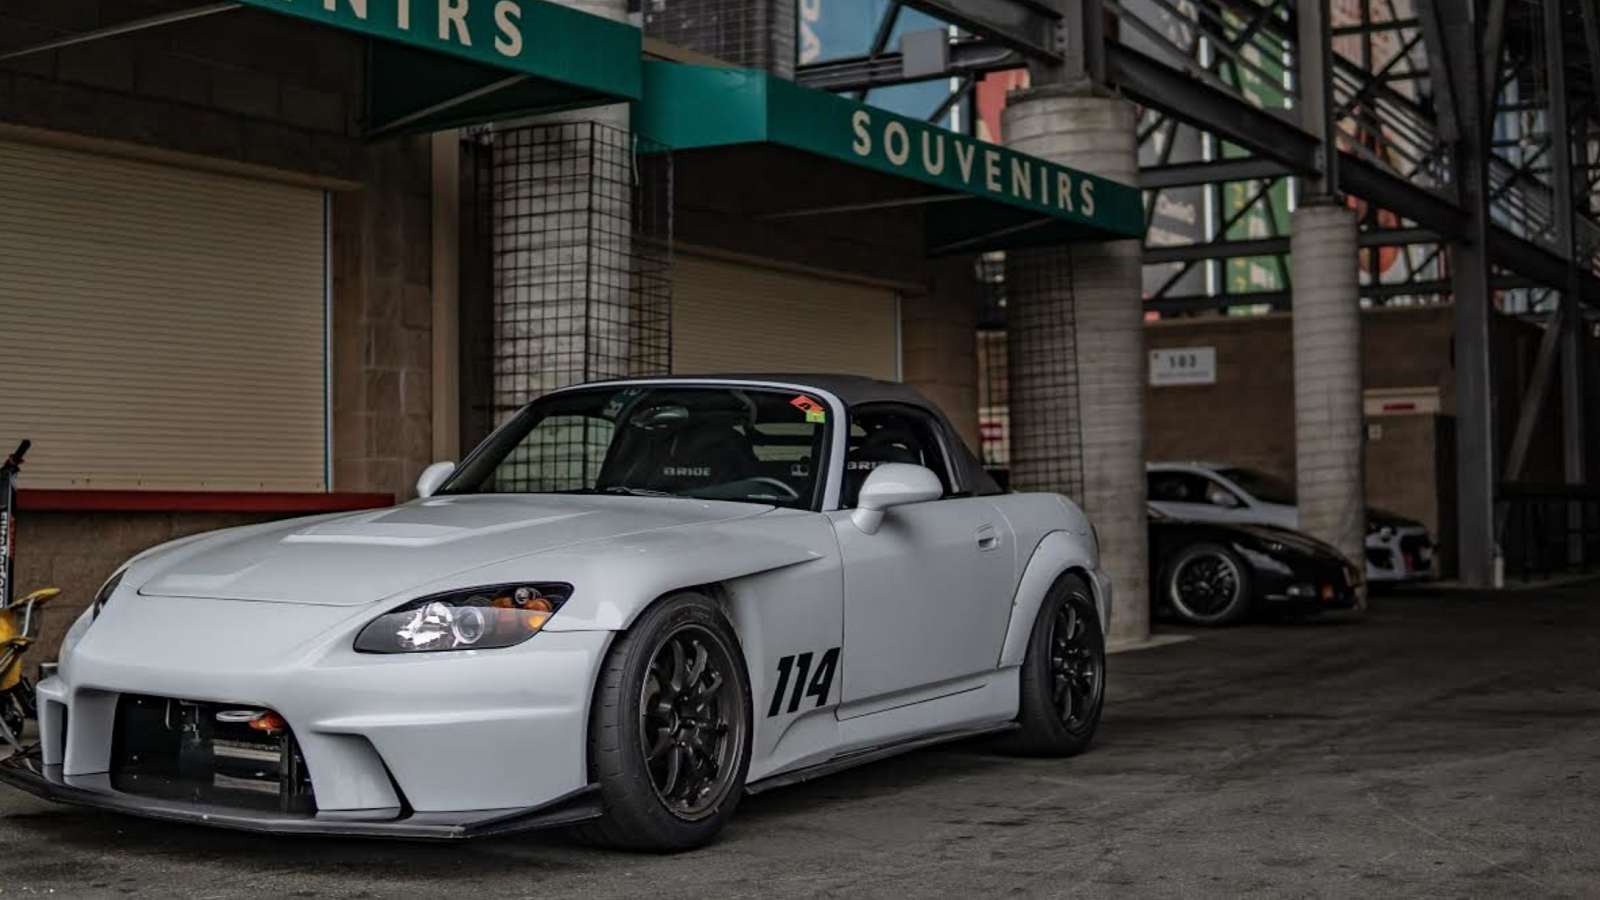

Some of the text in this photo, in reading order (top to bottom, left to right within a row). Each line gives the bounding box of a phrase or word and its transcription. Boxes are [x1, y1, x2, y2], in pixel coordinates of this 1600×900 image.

[852, 110, 1095, 216] SOUVENIRS
[663, 466, 711, 477] BRIDE
[767, 647, 840, 718] 114
